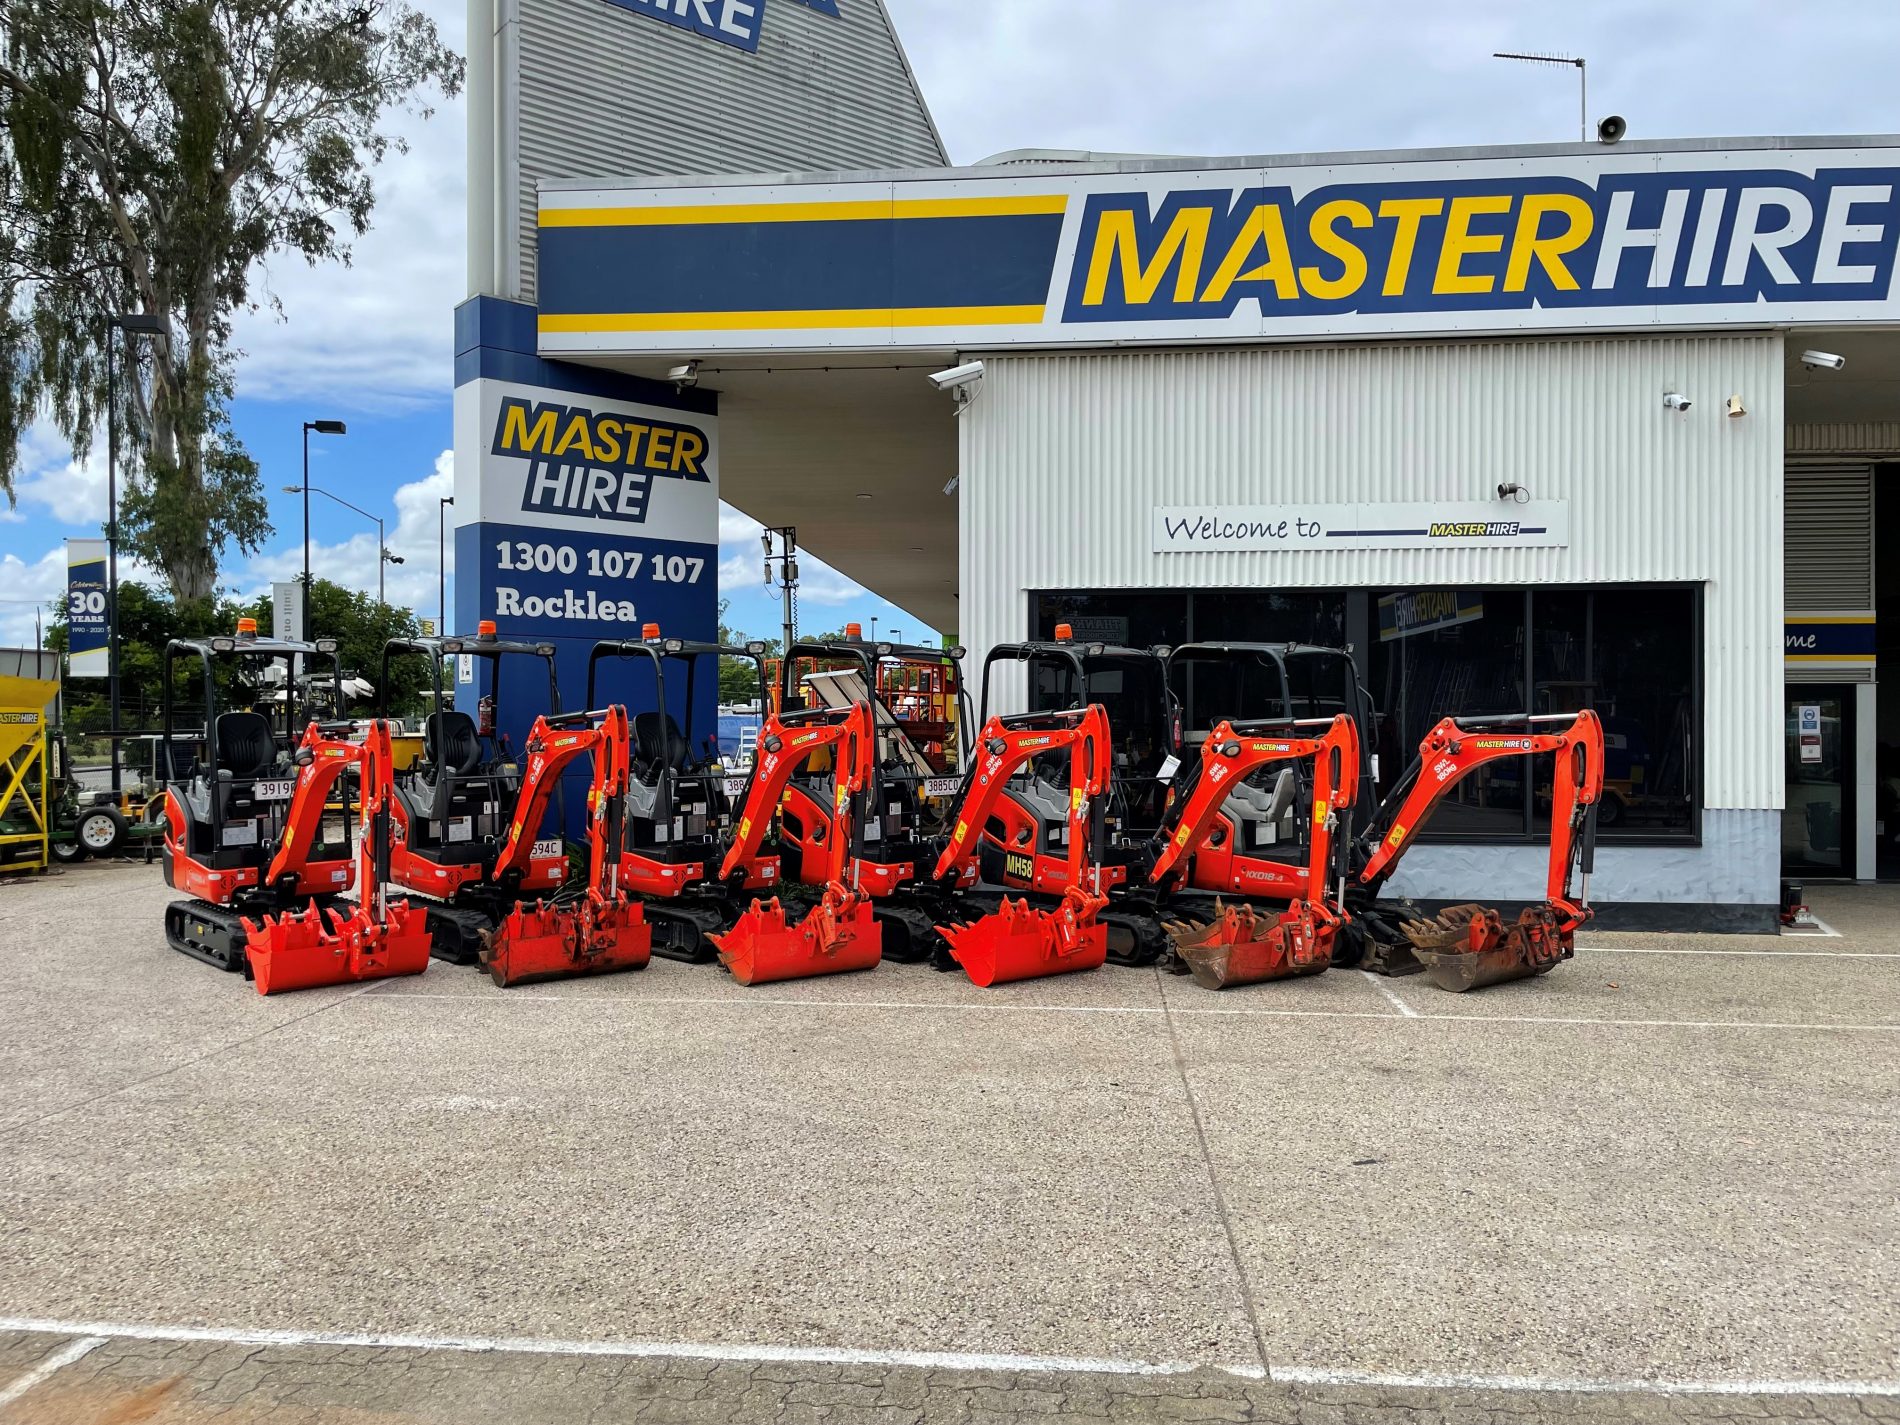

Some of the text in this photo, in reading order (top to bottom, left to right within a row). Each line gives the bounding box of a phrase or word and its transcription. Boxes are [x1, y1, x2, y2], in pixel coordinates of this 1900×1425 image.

[501, 405, 703, 475] MASTER
[530, 462, 647, 516] HIRE
[1165, 515, 1288, 540] Welcome
[1295, 517, 1321, 538] to
[496, 541, 705, 584] 1300 107 107
[70, 591, 106, 614] 30
[496, 587, 637, 622] Rocklea
[71, 615, 105, 623] YEARS
[1006, 854, 1033, 878] MH58
